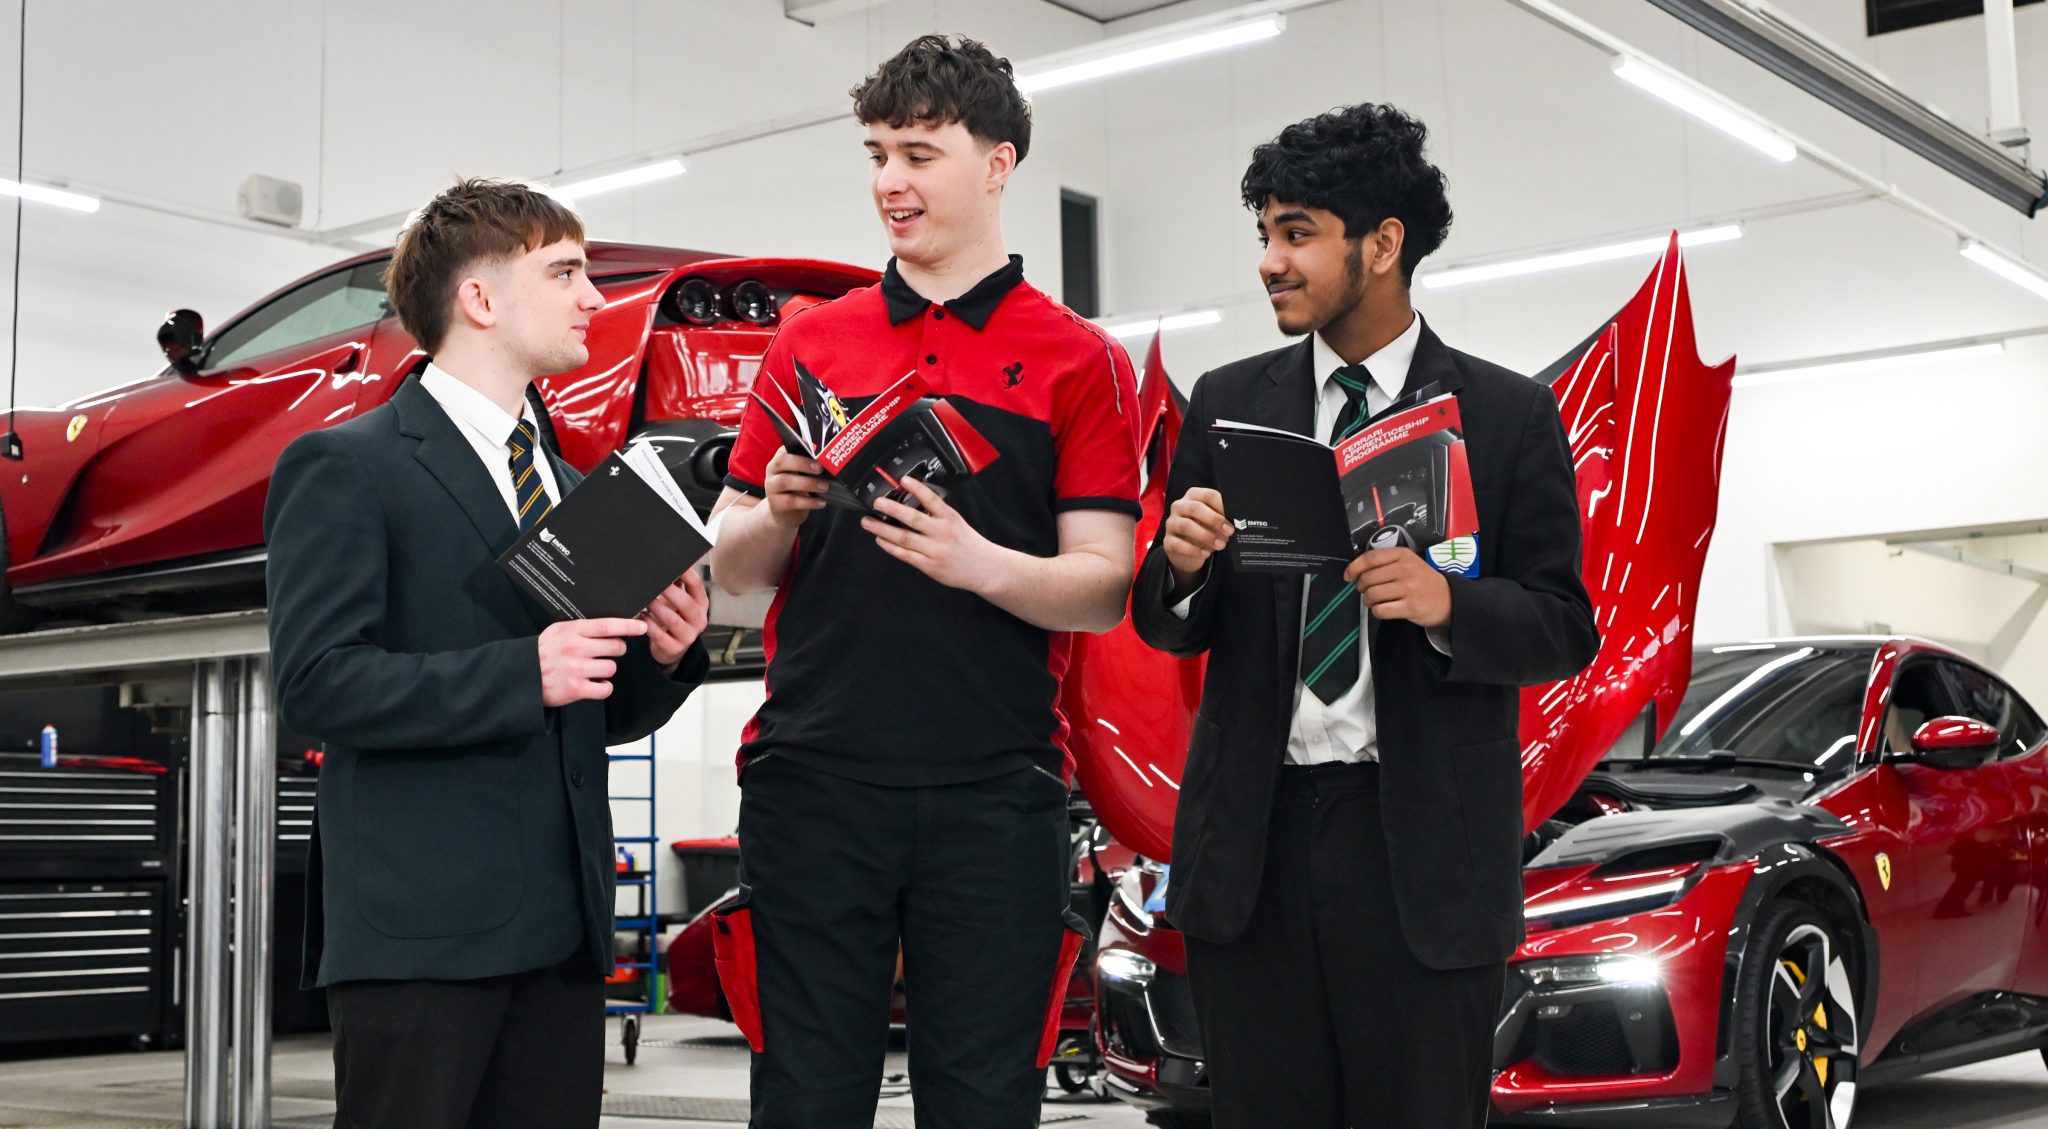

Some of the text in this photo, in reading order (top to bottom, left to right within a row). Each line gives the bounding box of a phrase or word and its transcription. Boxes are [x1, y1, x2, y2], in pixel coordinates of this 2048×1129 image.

[825, 423, 861, 460] FERRARI
[830, 396, 901, 464] APPRENTICESHIP
[833, 413, 888, 467] PROGRAMME
[1342, 428, 1383, 456] FERRARI
[1343, 416, 1430, 462] APPRENTICESHIP
[1344, 430, 1410, 468] PROGRAMME
[551, 538, 571, 556] EMTEC
